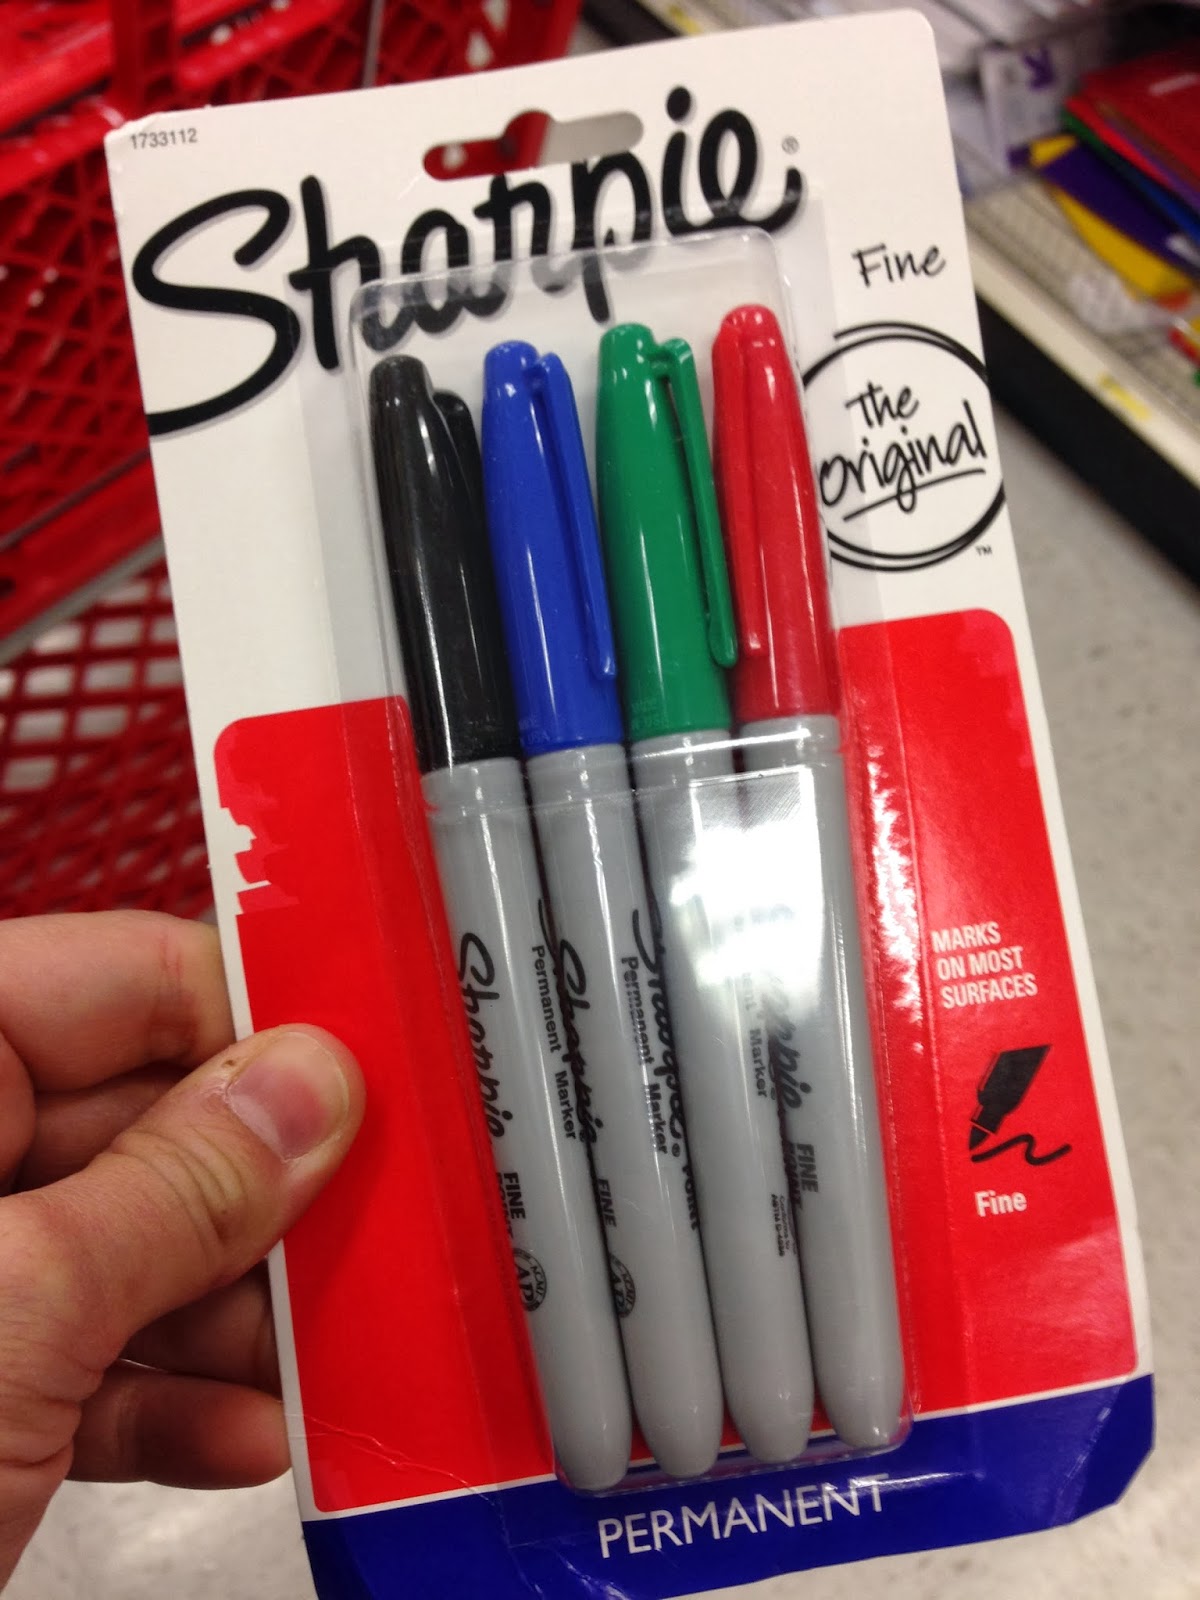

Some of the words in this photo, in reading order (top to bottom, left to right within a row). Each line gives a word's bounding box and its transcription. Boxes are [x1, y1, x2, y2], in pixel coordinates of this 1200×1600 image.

[130, 127, 198, 150] 1733112
[132, 85, 805, 437] Sharpie
[851, 242, 946, 288] Fine
[819, 399, 988, 514] original
[931, 921, 1001, 953] MARKS
[937, 956, 966, 982] ON
[967, 946, 1024, 977] MOST
[940, 973, 1038, 1010] SURFACES
[531, 944, 562, 1054] Permanent
[555, 1069, 576, 1140] Marker
[621, 955, 655, 1066] Permanent
[644, 1082, 669, 1155] Marker
[750, 1027, 768, 1099] Marker
[797, 1142, 819, 1193] FINE
[503, 1171, 527, 1220] FINE
[598, 1178, 618, 1228] FINE
[974, 1189, 1028, 1217] Fine
[597, 1473, 890, 1559] PERMANENT
